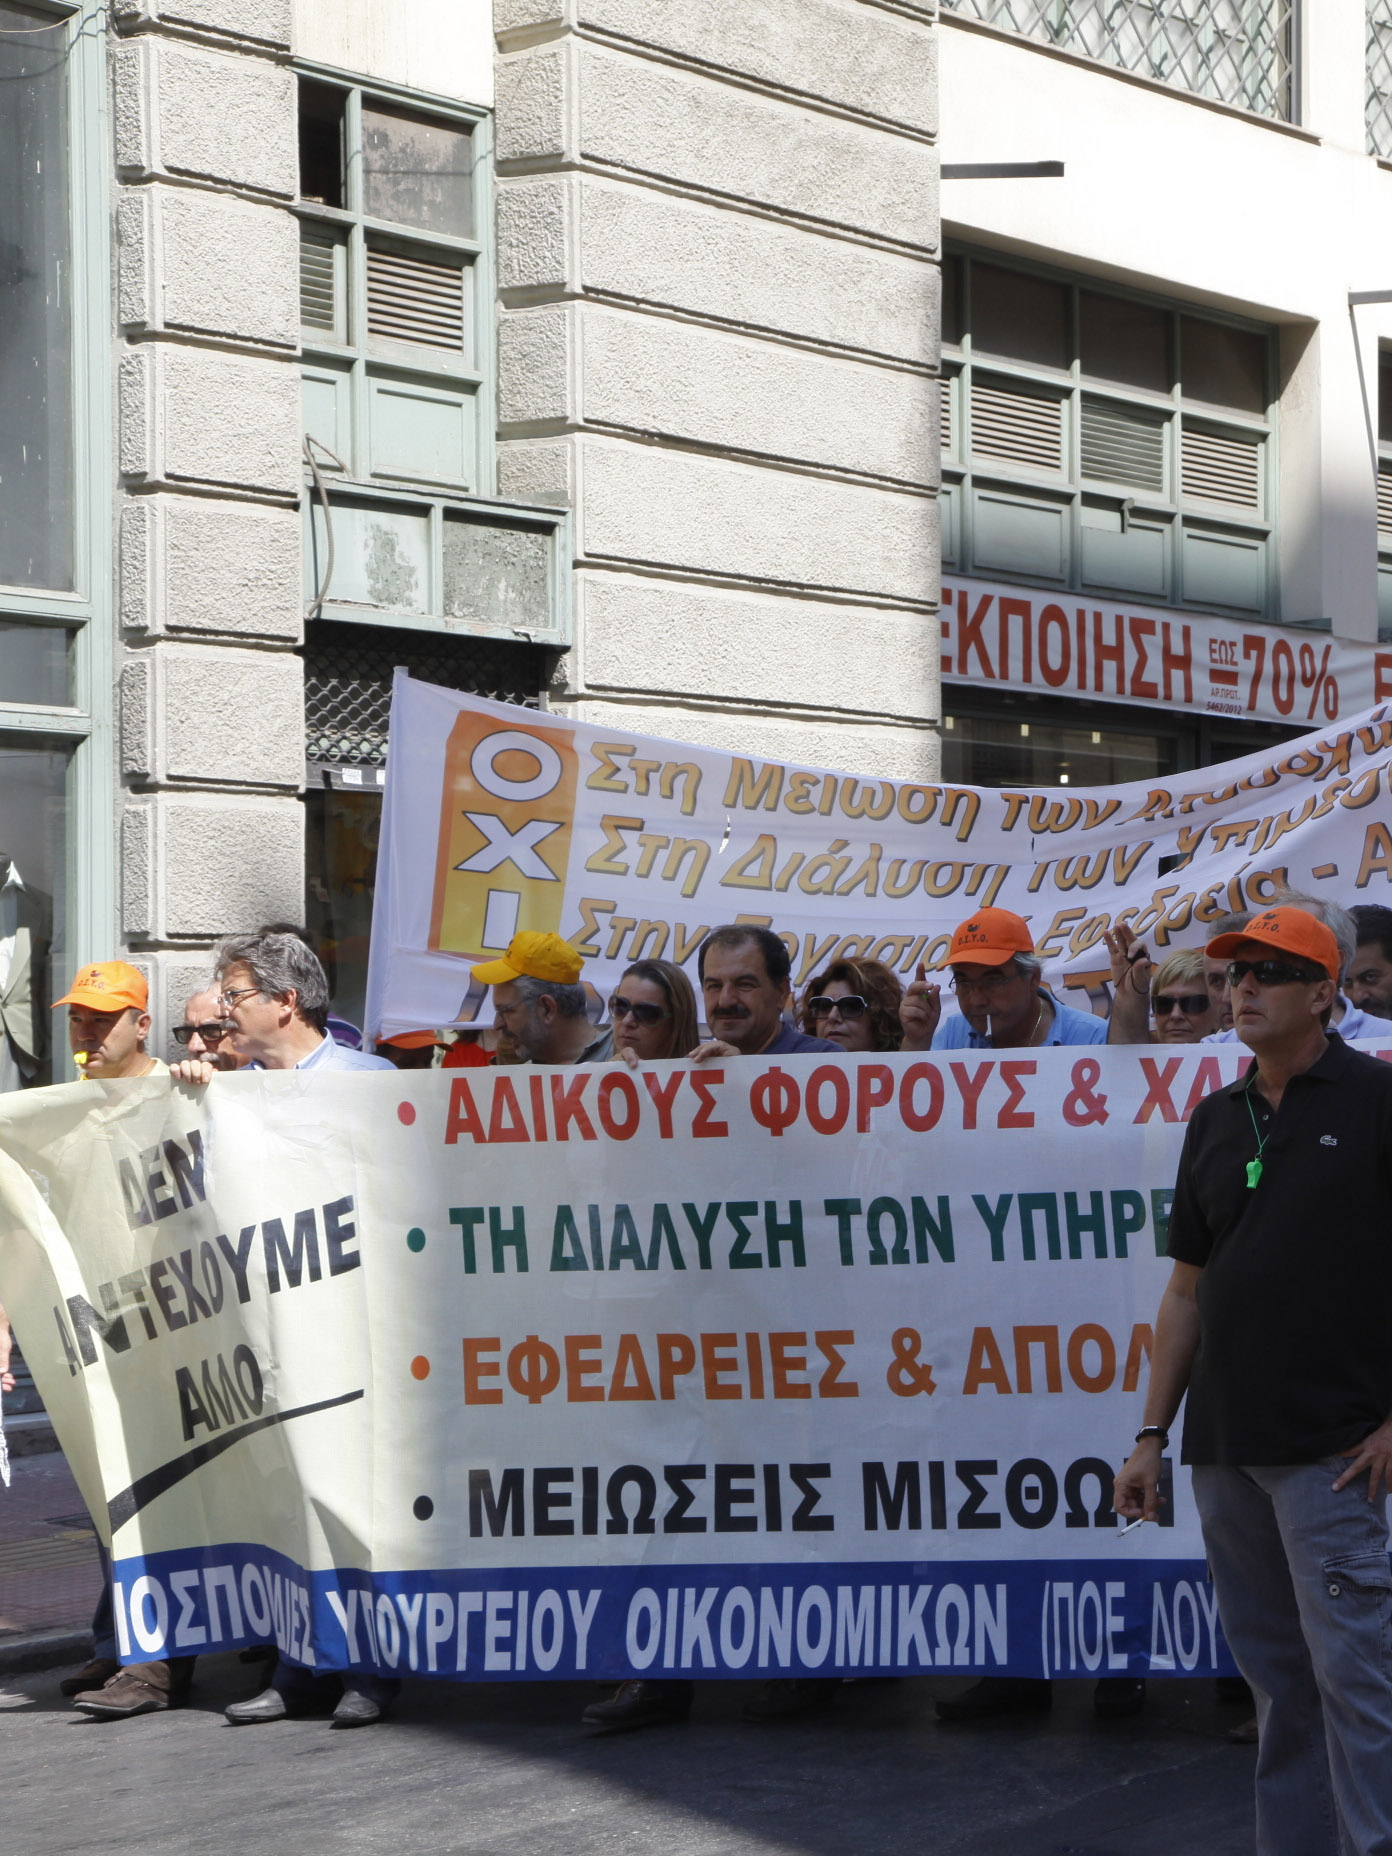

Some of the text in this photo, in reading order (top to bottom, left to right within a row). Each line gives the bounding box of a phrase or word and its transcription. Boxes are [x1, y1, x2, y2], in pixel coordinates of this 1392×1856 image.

[1209, 638, 1239, 667] ΕΩΣ
[585, 741, 702, 817] Στη
[1000, 793, 1122, 836] των
[452, 729, 566, 951] ΟΧΙ
[584, 814, 711, 898] Στη
[719, 834, 1010, 908] Διάλυση
[1027, 841, 1154, 893] των
[566, 897, 711, 965] Στην
[444, 1069, 726, 1145] ΑΔΙΚΟΥΣ
[749, 1059, 1038, 1137] ΦΟΡΟΥΣ
[1062, 1058, 1110, 1127] &
[117, 1129, 207, 1232] ΔΕΝ
[449, 1204, 528, 1274] ΤΗ
[549, 1199, 806, 1273] ΔΙΑΛΥΣΗ
[825, 1196, 956, 1267] ΤΩΝ
[54, 1195, 361, 1377] ΑΝΤΕΧΟΥΜΕ
[462, 1329, 859, 1405] ΕΦΕΔΡΕΙΕΣ
[888, 1327, 937, 1397] &
[469, 1462, 835, 1538] ΜΕΙΩΣΕΙΣ
[325, 1588, 602, 1672] ΥΠΟΥΡΓΕΙΟΥ
[626, 1583, 1008, 1671] ΟΙΚΟΝΟΜΙΚΩΝ
